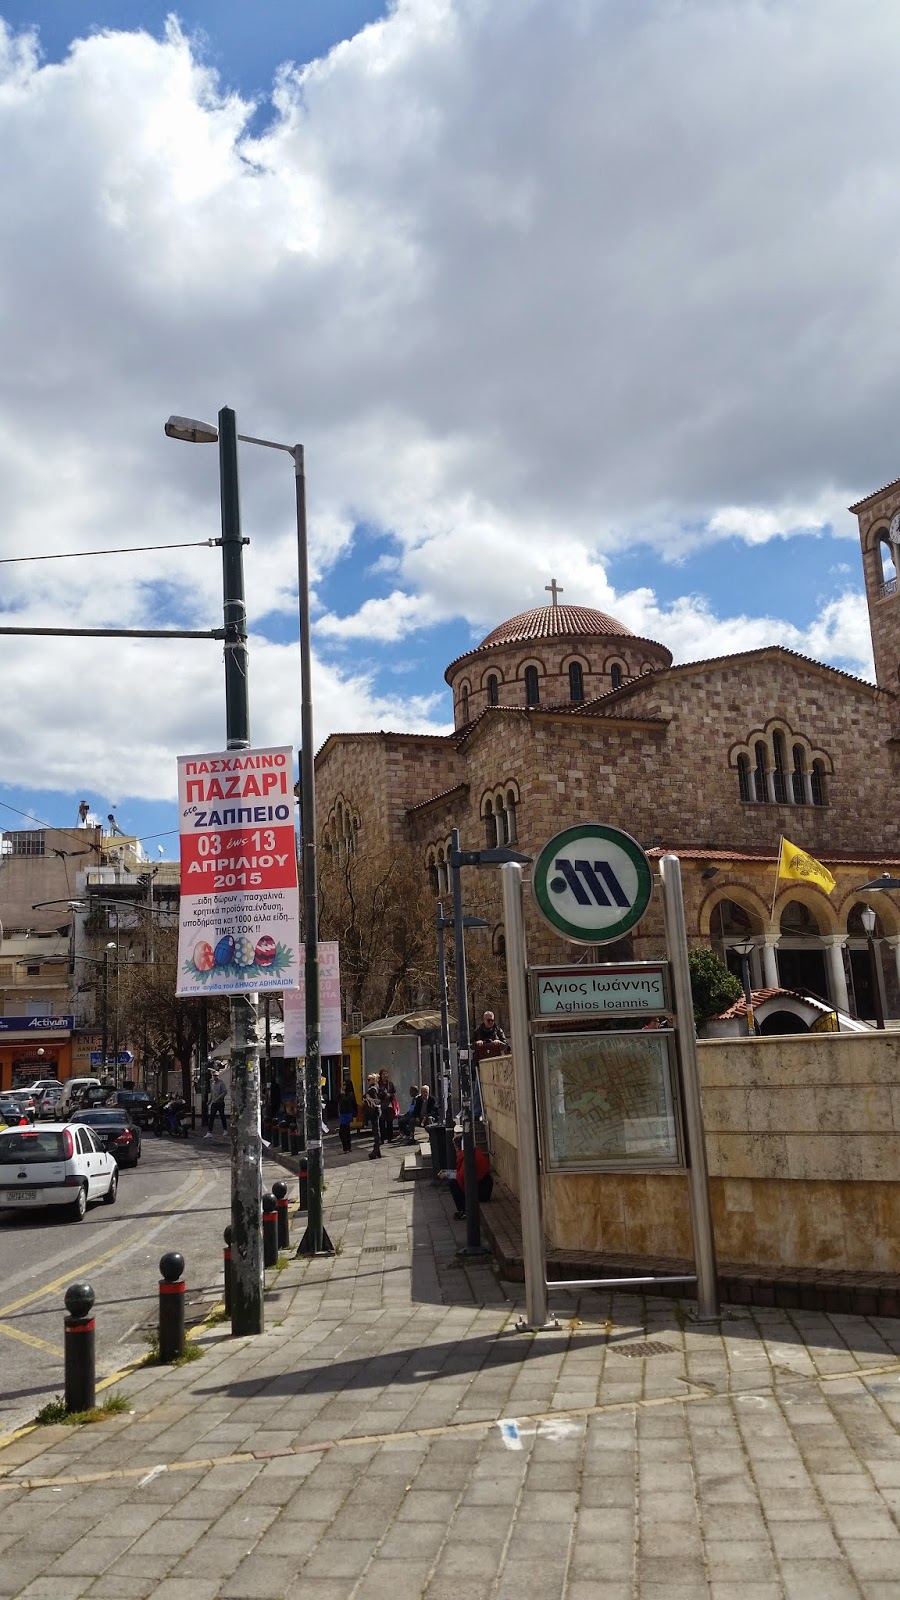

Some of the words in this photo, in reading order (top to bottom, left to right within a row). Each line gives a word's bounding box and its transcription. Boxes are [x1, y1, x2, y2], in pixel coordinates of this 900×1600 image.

[186, 754, 286, 775] ΠΑΣΧΑΛΙΝΟ
[186, 772, 287, 803] ΠΑΖΑΡΙ
[194, 804, 290, 828] ΖΑΠΠΕΙΟ
[197, 834, 222, 856] 03
[251, 830, 276, 852] 13
[187, 854, 289, 874] ΑΠΡΙΛΙΟΥ
[213, 872, 262, 888] 2015
[193, 906, 220, 918] κρητικά
[182, 917, 222, 928] υποδήματα
[234, 915, 252, 923] 1000
[253, 914, 271, 922] άλλα
[215, 926, 236, 936] ΤΙΜΕΣ
[237, 925, 254, 934] ΣΟΚ
[234, 981, 258, 989] ΔΗΜΟΥ
[259, 978, 294, 987] ΑΘΗΝΑΙΩΝ
[542, 981, 588, 996] Αγιος
[592, 979, 660, 993] Ιωάννης
[555, 1000, 600, 1012] Aghios
[603, 998, 649, 1009] Ioannis
